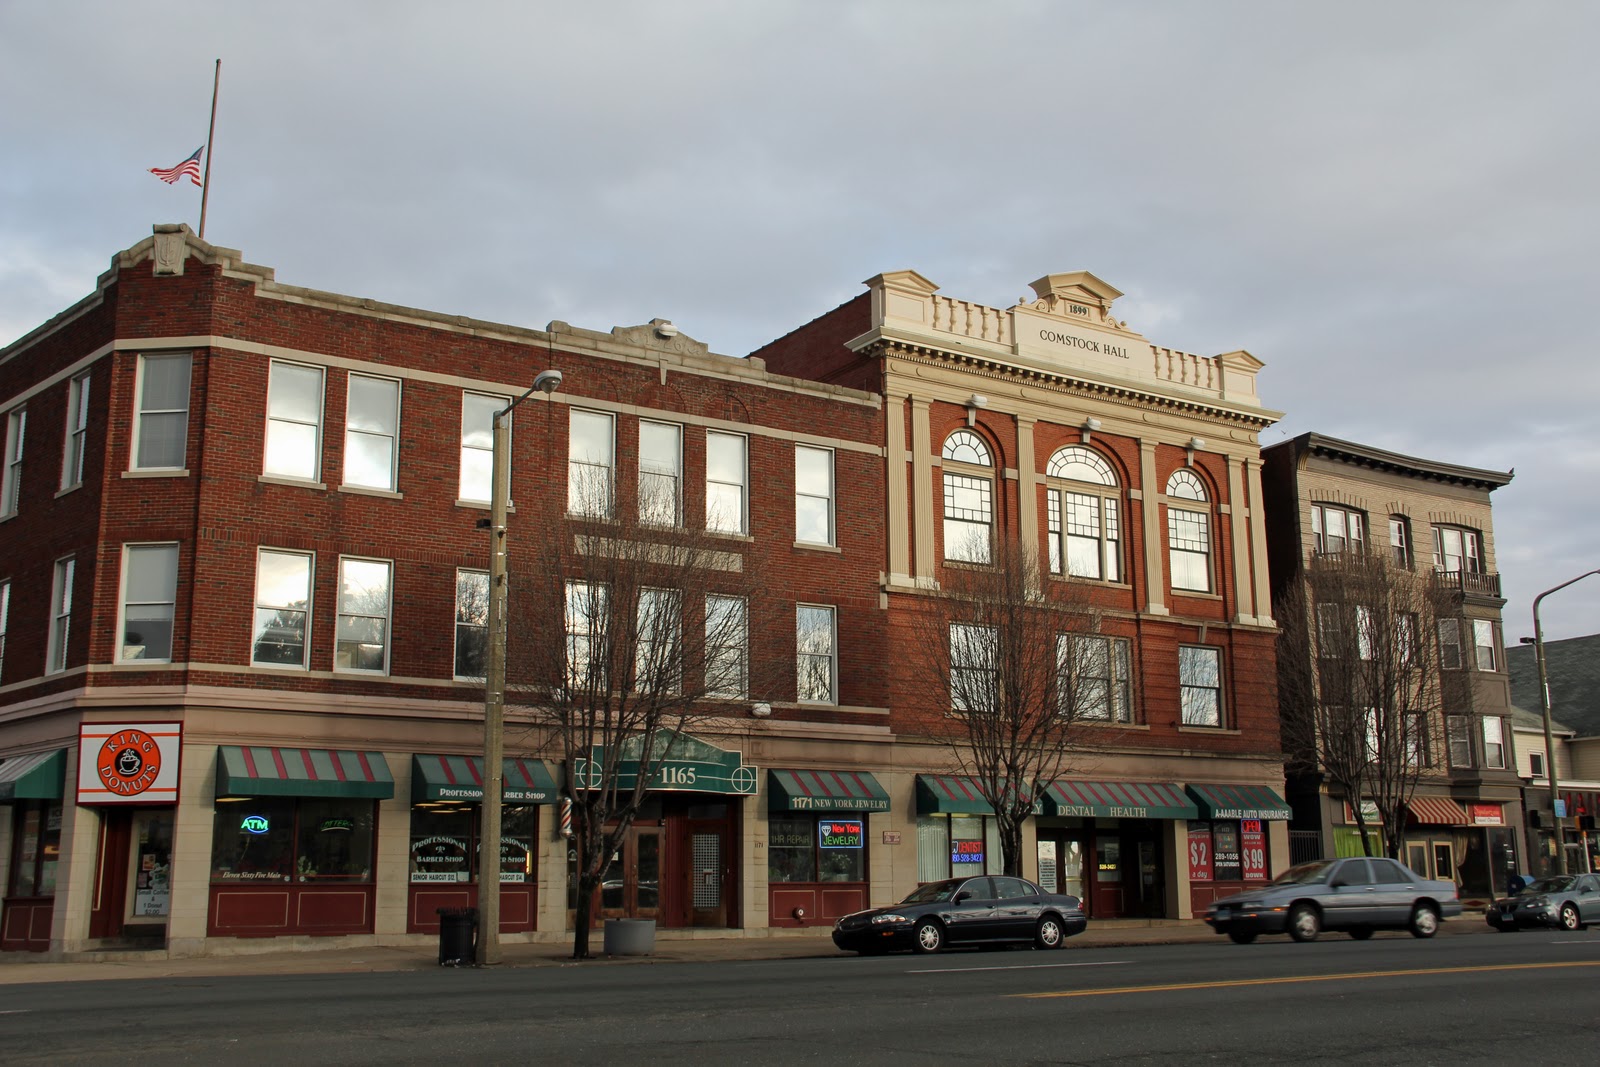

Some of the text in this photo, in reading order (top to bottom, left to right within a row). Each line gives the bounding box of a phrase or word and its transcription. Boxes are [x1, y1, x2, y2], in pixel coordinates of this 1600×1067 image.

[1069, 304, 1087, 316] 1899
[1040, 329, 1130, 359] COMSTOCK HALL
[107, 733, 153, 752] KING
[101, 764, 157, 792] DONUTS
[661, 766, 695, 784] 1165
[440, 788, 484, 797] PROFESSION
[793, 797, 888, 809] 1171 NEW YORK JEWELRY
[1058, 805, 1096, 816] DENTAL
[1110, 807, 1147, 818] HEALTH
[1215, 809, 1289, 819] A-AAABLE AUTO INSURANCE
[241, 819, 269, 829] ATM
[1243, 821, 1260, 832] OPEN
[412, 836, 467, 853] PROFESSIONAL
[787, 835, 809, 844] REPAIR
[824, 836, 858, 845] JEWELRY
[959, 842, 982, 853] DENTIST
[1190, 841, 1207, 868] $2
[1243, 848, 1264, 870] $99
[1197, 871, 1208, 879] day
